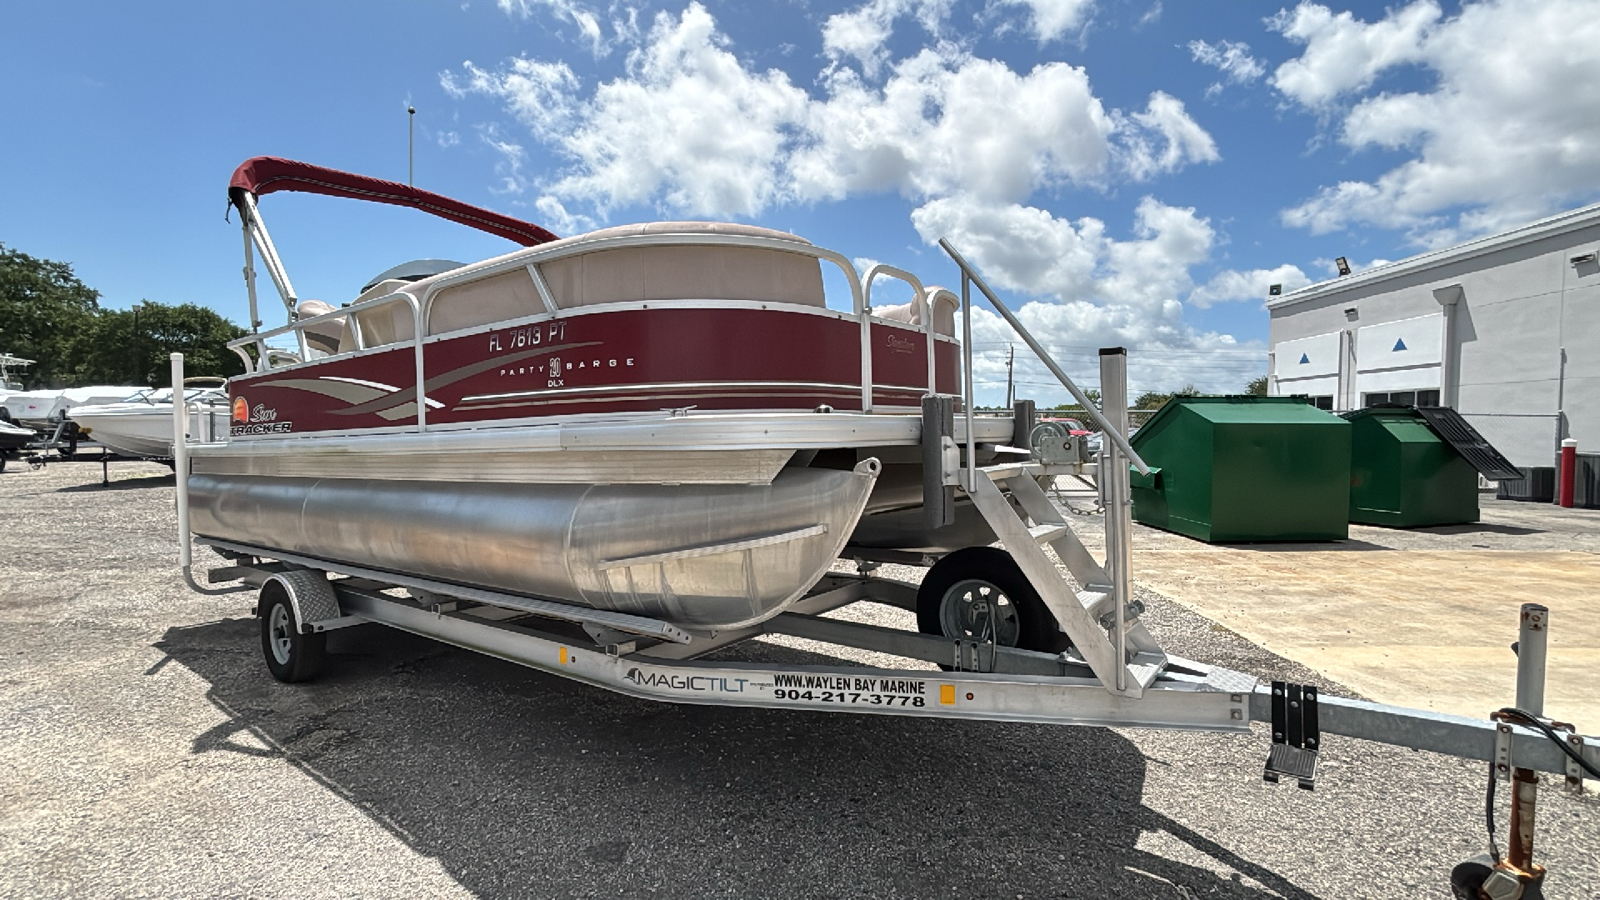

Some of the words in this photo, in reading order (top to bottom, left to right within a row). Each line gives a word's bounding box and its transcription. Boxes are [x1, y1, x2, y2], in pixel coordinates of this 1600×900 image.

[490, 334, 502, 352] FL
[510, 327, 541, 348] 7613
[549, 321, 567, 342] PT
[500, 366, 543, 376] PARTY
[549, 357, 561, 377] 20
[566, 358, 634, 370] BARGE
[250, 403, 277, 421] Sun
[230, 422, 292, 435] TRACKER
[638, 669, 749, 692] MAGICTILT
[774, 674, 851, 691] WWW.WAYLEN
[854, 678, 877, 692] BAY
[880, 679, 926, 695] MARINE
[774, 688, 926, 708] 904-217-3778
